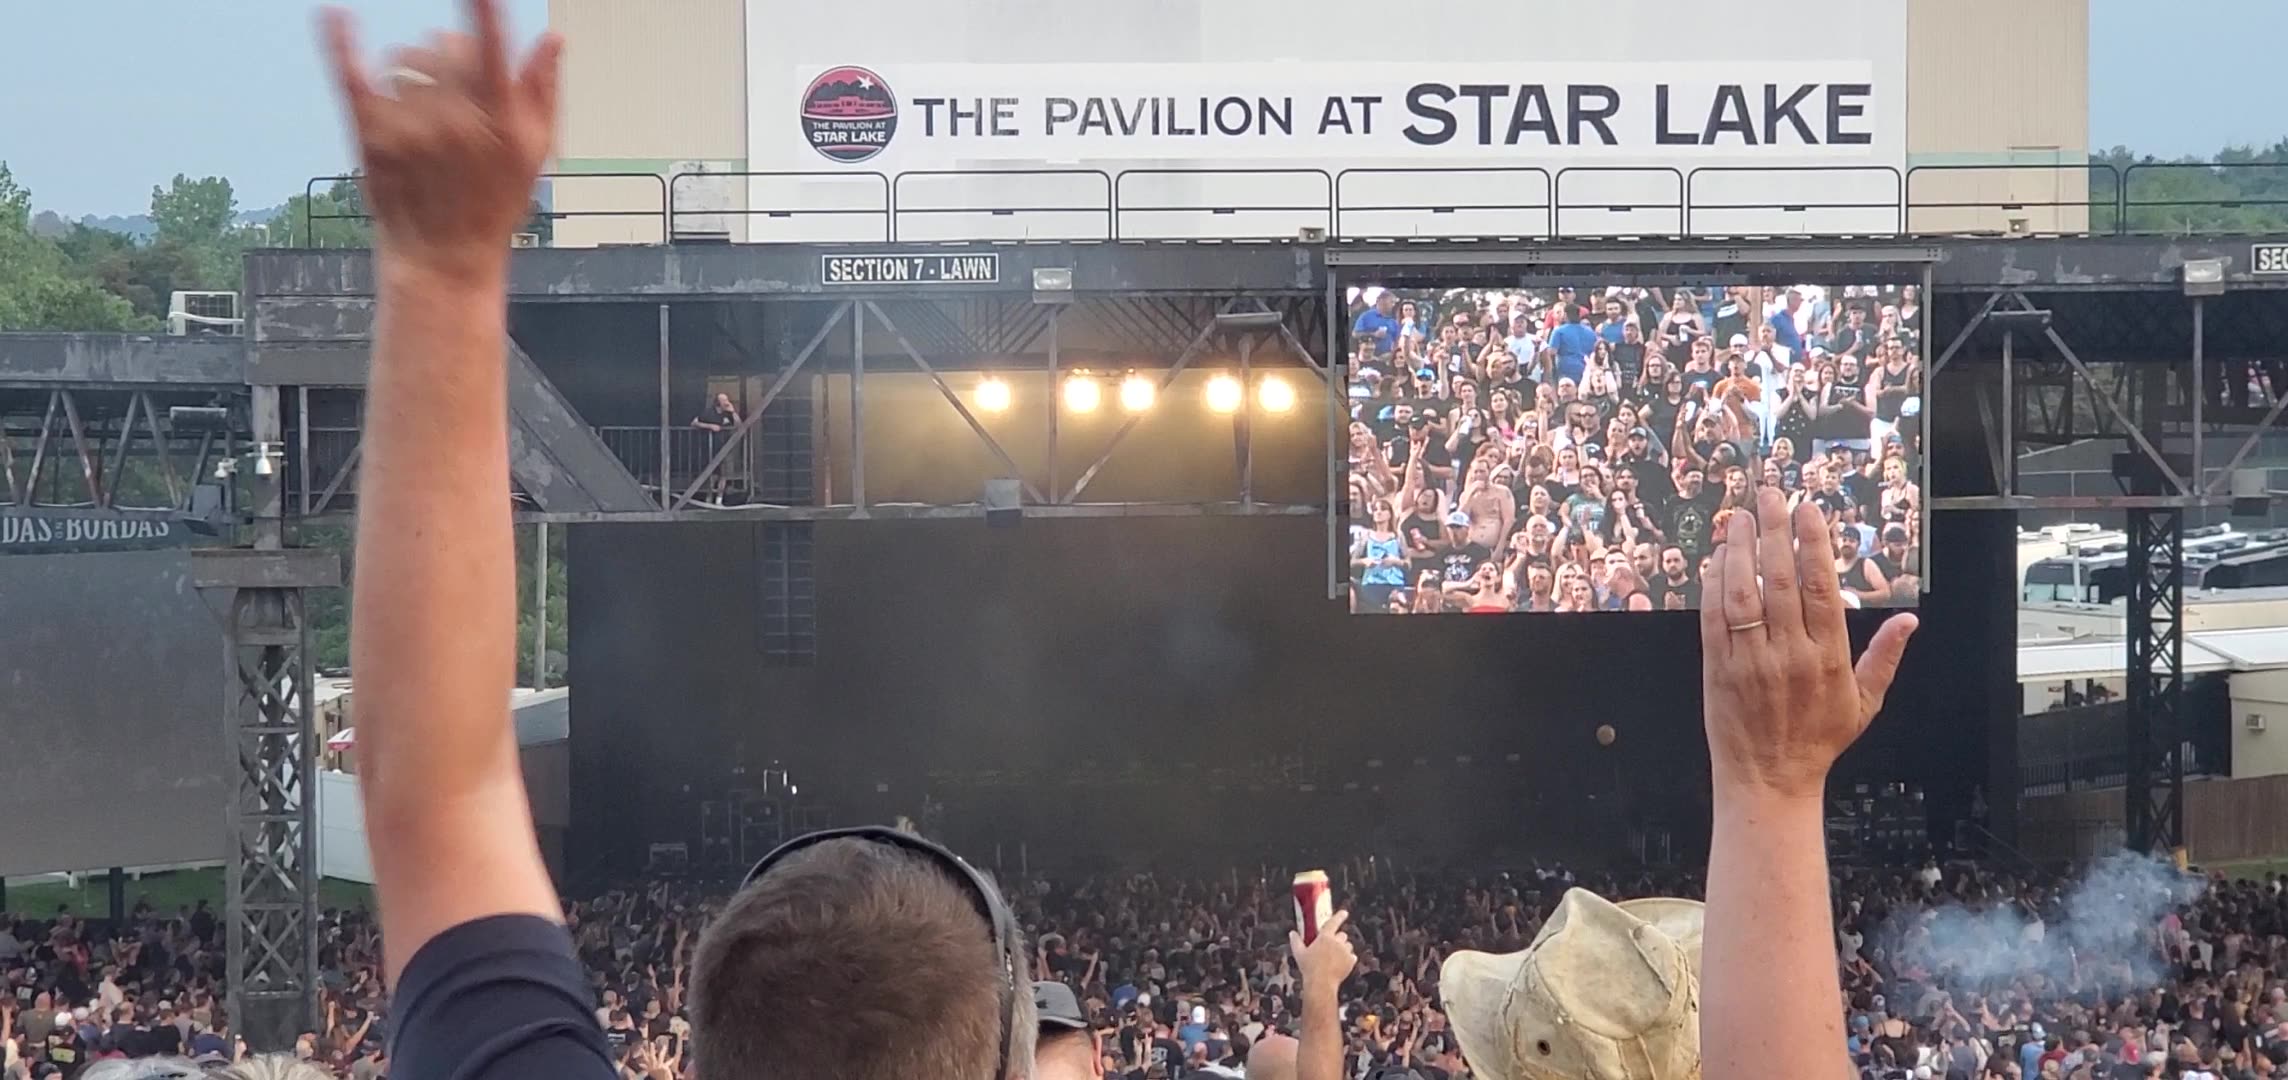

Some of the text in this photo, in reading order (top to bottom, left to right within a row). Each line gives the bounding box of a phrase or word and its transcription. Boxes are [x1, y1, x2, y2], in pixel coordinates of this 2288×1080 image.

[912, 83, 1873, 146] THE PAVILION AT STAR LAKE
[813, 121, 886, 130] THE PAVILION AT
[813, 131, 886, 143] STAR LAKE
[830, 258, 909, 281] SECTION
[914, 258, 924, 280] 7
[940, 257, 992, 280] LAWN
